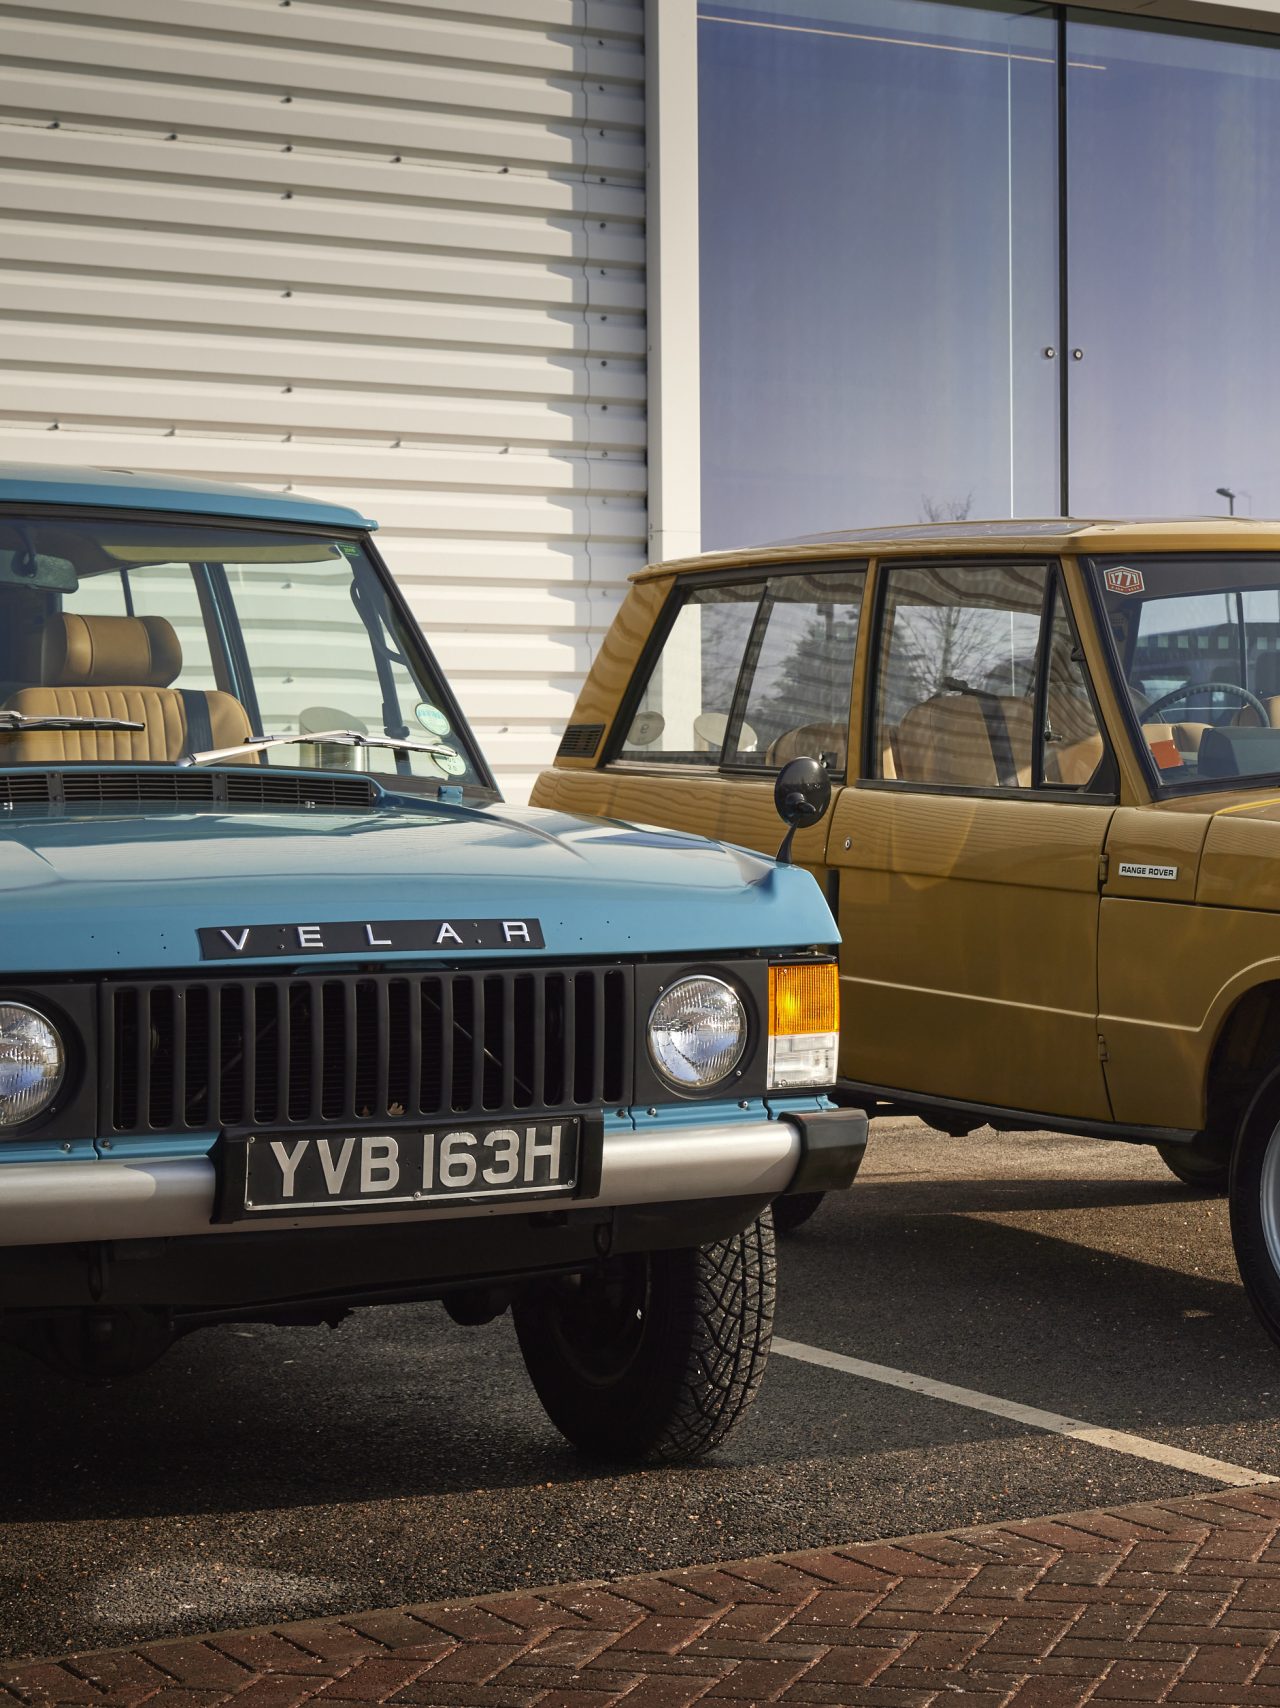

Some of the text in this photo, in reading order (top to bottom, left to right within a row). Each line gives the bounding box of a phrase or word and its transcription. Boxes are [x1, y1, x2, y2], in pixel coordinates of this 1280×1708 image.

[1110, 571, 1138, 587] 1771
[1121, 866, 1174, 877] RANGE ROVER
[220, 921, 531, 951] VELAR
[270, 1125, 562, 1197] YVB 163H
